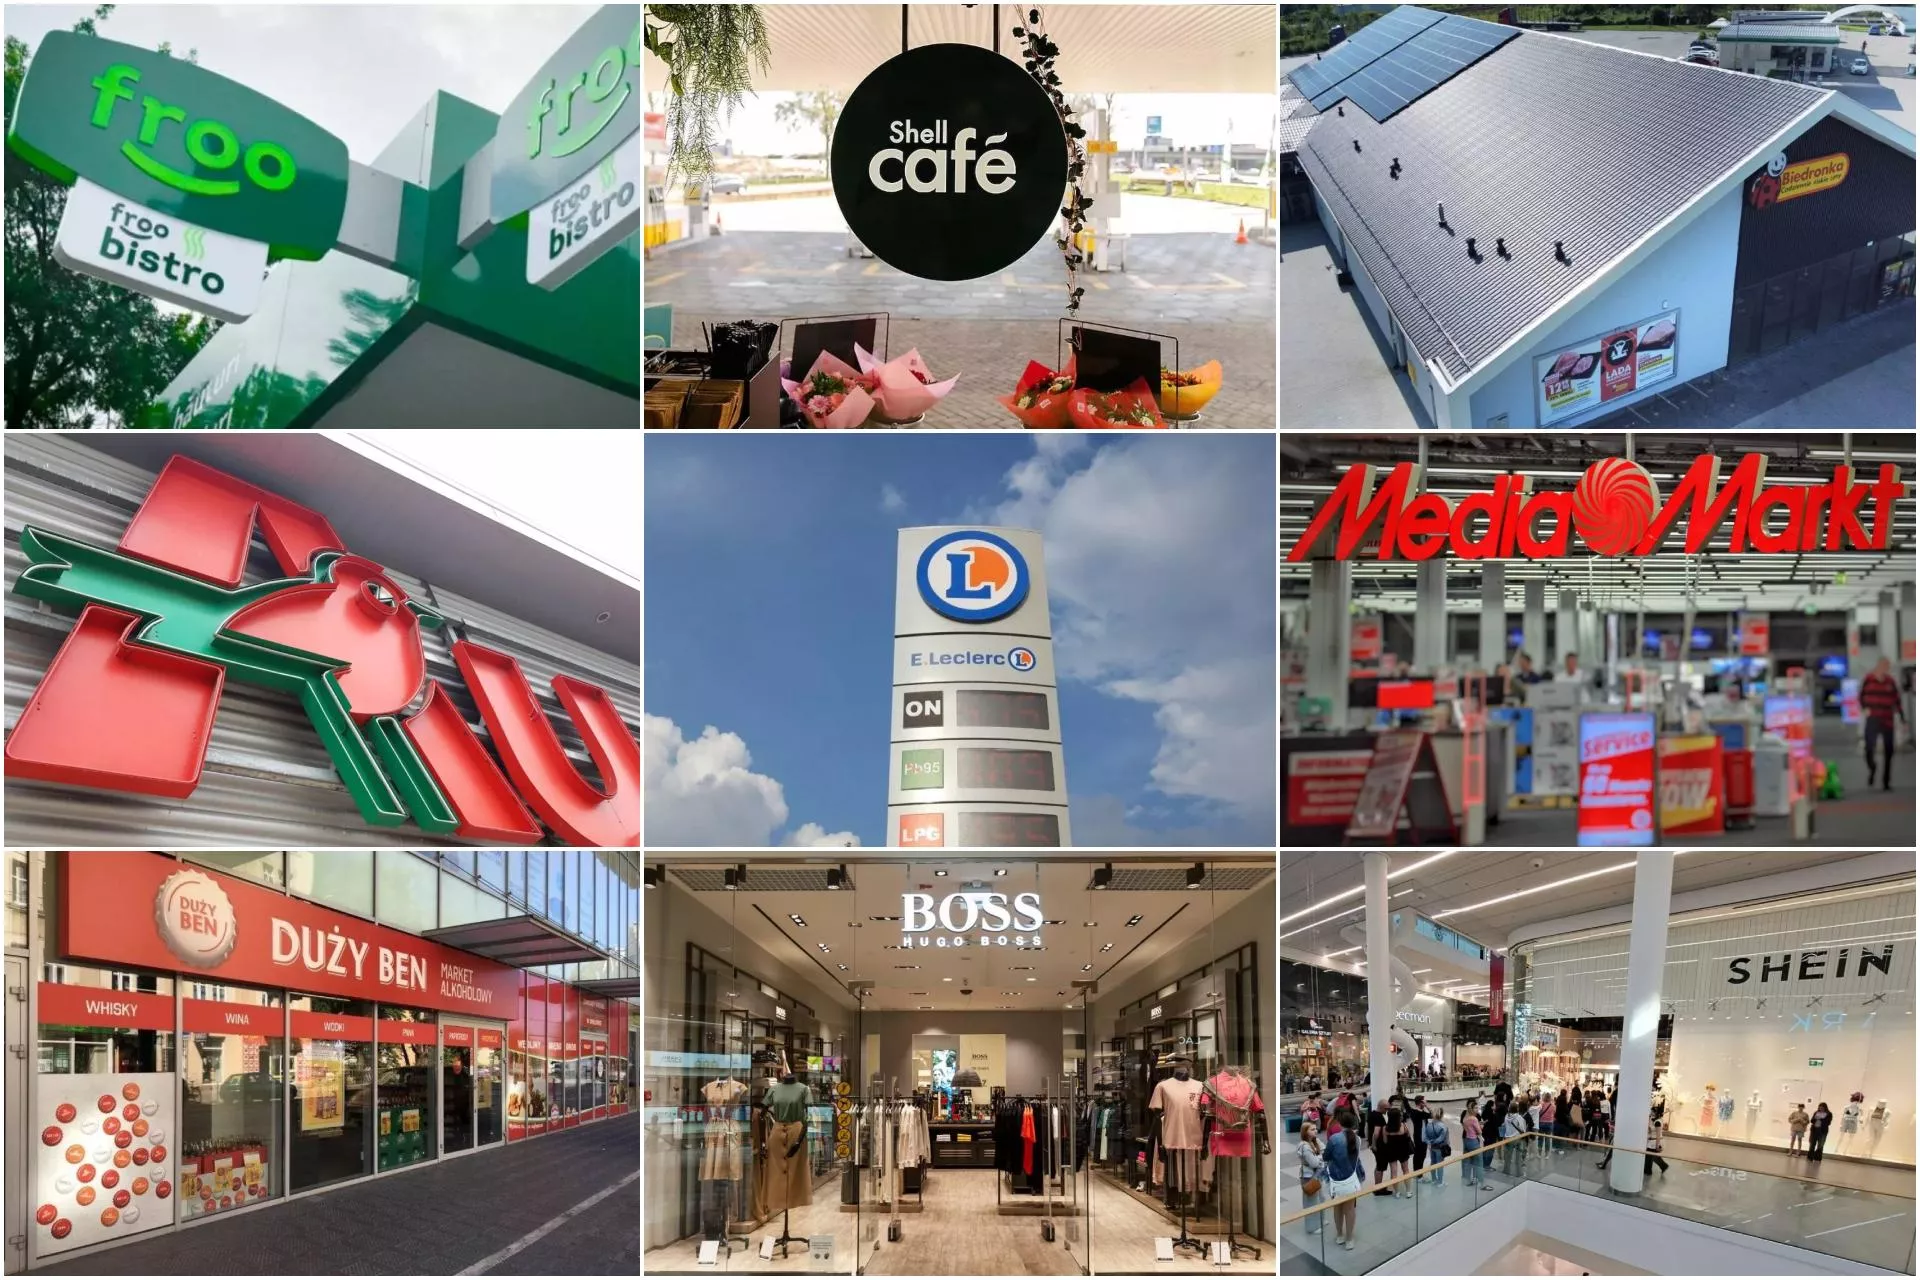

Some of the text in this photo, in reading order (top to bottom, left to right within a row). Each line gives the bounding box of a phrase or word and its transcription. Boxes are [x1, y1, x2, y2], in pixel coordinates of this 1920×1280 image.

[91, 64, 297, 191] froo
[889, 119, 947, 144] Shell
[868, 127, 1016, 195] café
[1782, 161, 1844, 186] Biedronka
[551, 184, 591, 223] froo
[111, 203, 170, 239] froo
[550, 181, 634, 259] bistro
[99, 225, 225, 295] bistro
[1606, 364, 1632, 379] LADA
[1286, 453, 1908, 561] Media Markt
[945, 553, 991, 599] L
[911, 651, 1005, 667] E.Leclerc
[905, 699, 940, 717] ON
[904, 761, 940, 776] Pb95
[902, 824, 940, 842] LPG
[180, 895, 217, 917] DUŻY
[901, 892, 1044, 933] BOSS
[180, 914, 218, 938] BEN
[903, 935, 1041, 947] HUGO BOSS
[271, 917, 428, 993] DUŻY BEN
[1727, 944, 1894, 985] SHEIN
[440, 962, 474, 985] MARKET
[440, 983, 493, 1005] ALKOHOLOWY
[86, 1000, 138, 1018] WHISKY
[225, 1012, 250, 1025] WINA
